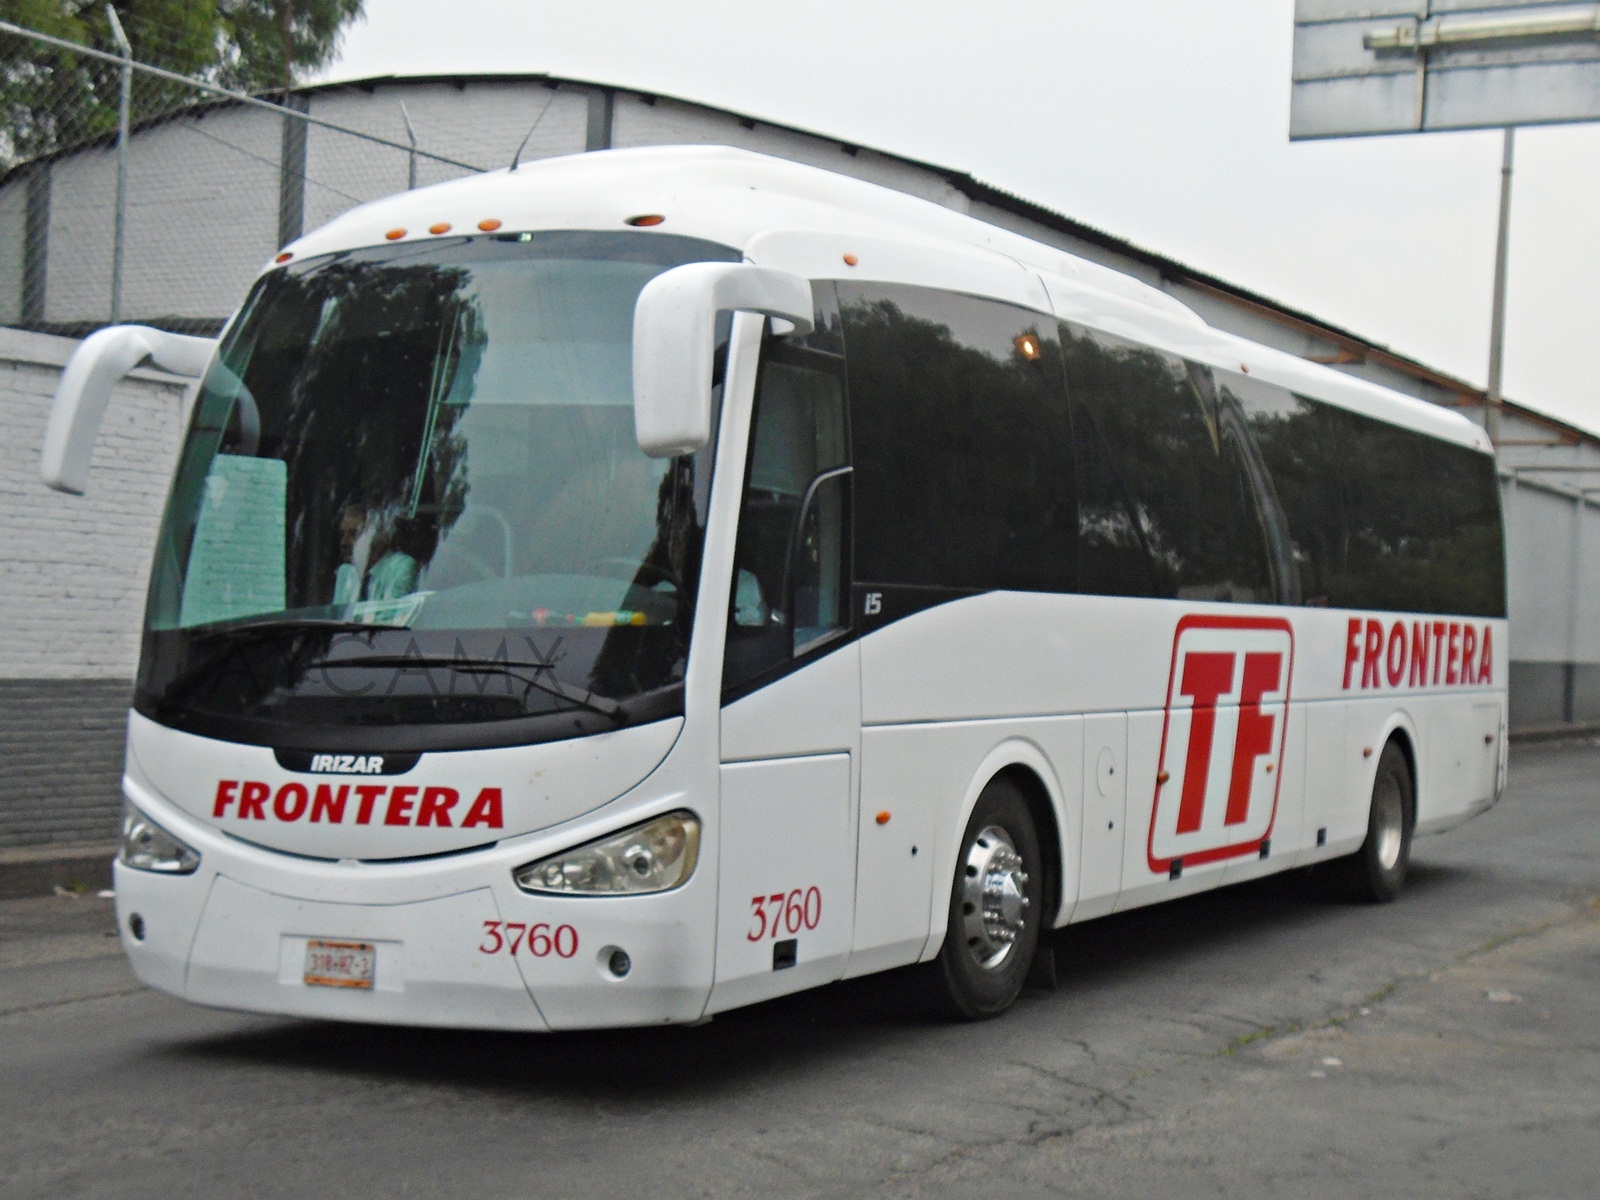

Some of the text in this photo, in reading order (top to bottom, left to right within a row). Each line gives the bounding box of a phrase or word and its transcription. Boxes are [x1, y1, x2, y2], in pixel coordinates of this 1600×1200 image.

[1342, 617, 1492, 690] FRONTERA
[310, 754, 385, 774] IRIZAR
[1175, 652, 1284, 834] TF
[213, 780, 504, 829] FRONTERA
[479, 921, 578, 959] 3760
[747, 885, 822, 943] 3760
